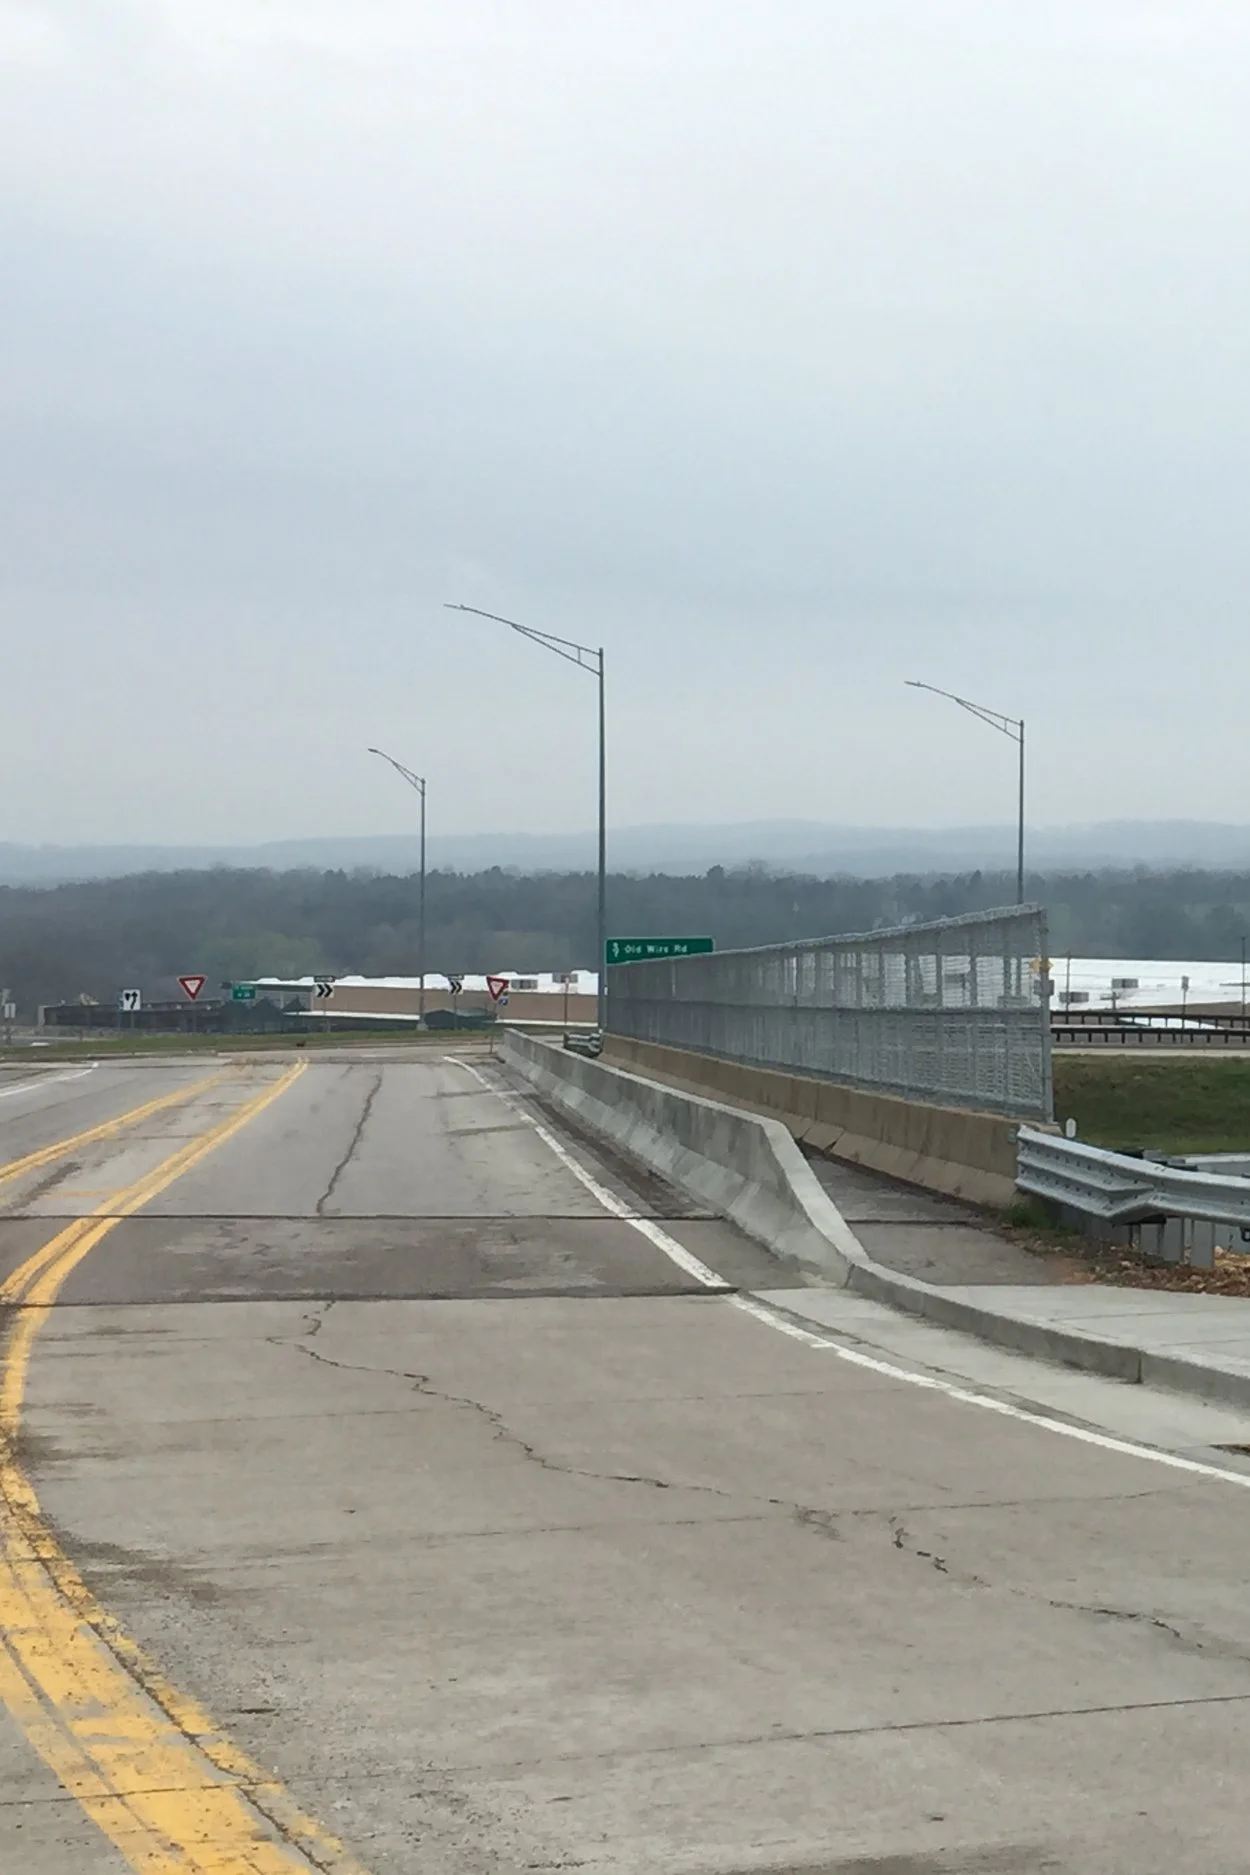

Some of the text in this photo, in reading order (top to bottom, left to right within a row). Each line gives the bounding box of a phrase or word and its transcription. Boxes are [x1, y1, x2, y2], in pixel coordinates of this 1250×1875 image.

[624, 943, 688, 954] Old Wire Rd
